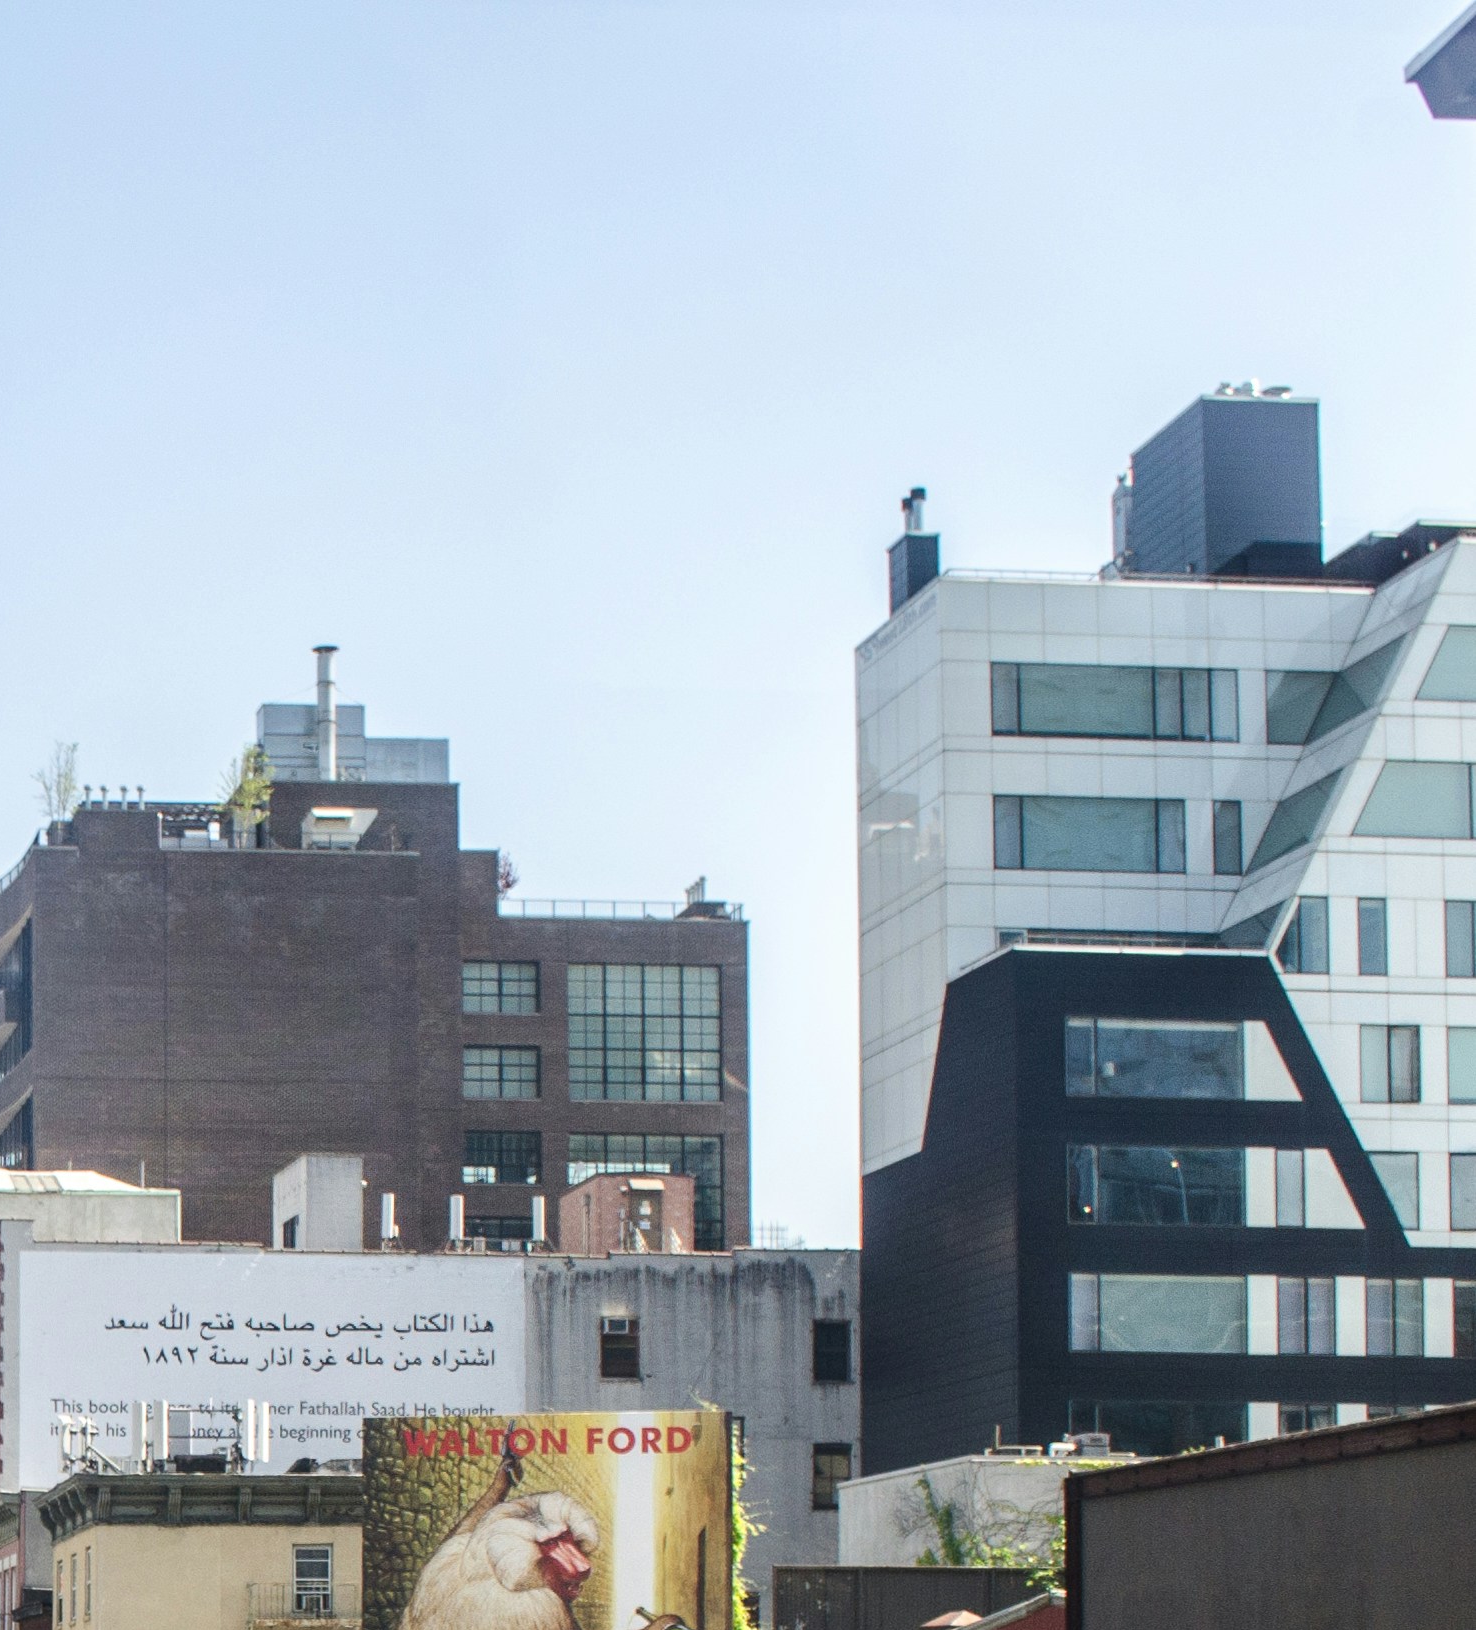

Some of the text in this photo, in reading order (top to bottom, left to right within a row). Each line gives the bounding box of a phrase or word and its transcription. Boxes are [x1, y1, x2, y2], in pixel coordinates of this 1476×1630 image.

[105, 1303, 493, 1340] هذا الكتاب يخص صاحبه فتح الله سعد
[51, 1400, 84, 1415] This
[88, 1399, 128, 1415] book
[299, 1401, 365, 1416] Fathallah
[371, 1401, 409, 1417] Saad.
[414, 1402, 436, 1417] He
[106, 1424, 126, 1438] his
[279, 1425, 351, 1443] beginning
[403, 1426, 694, 1457] WALTON FORD
